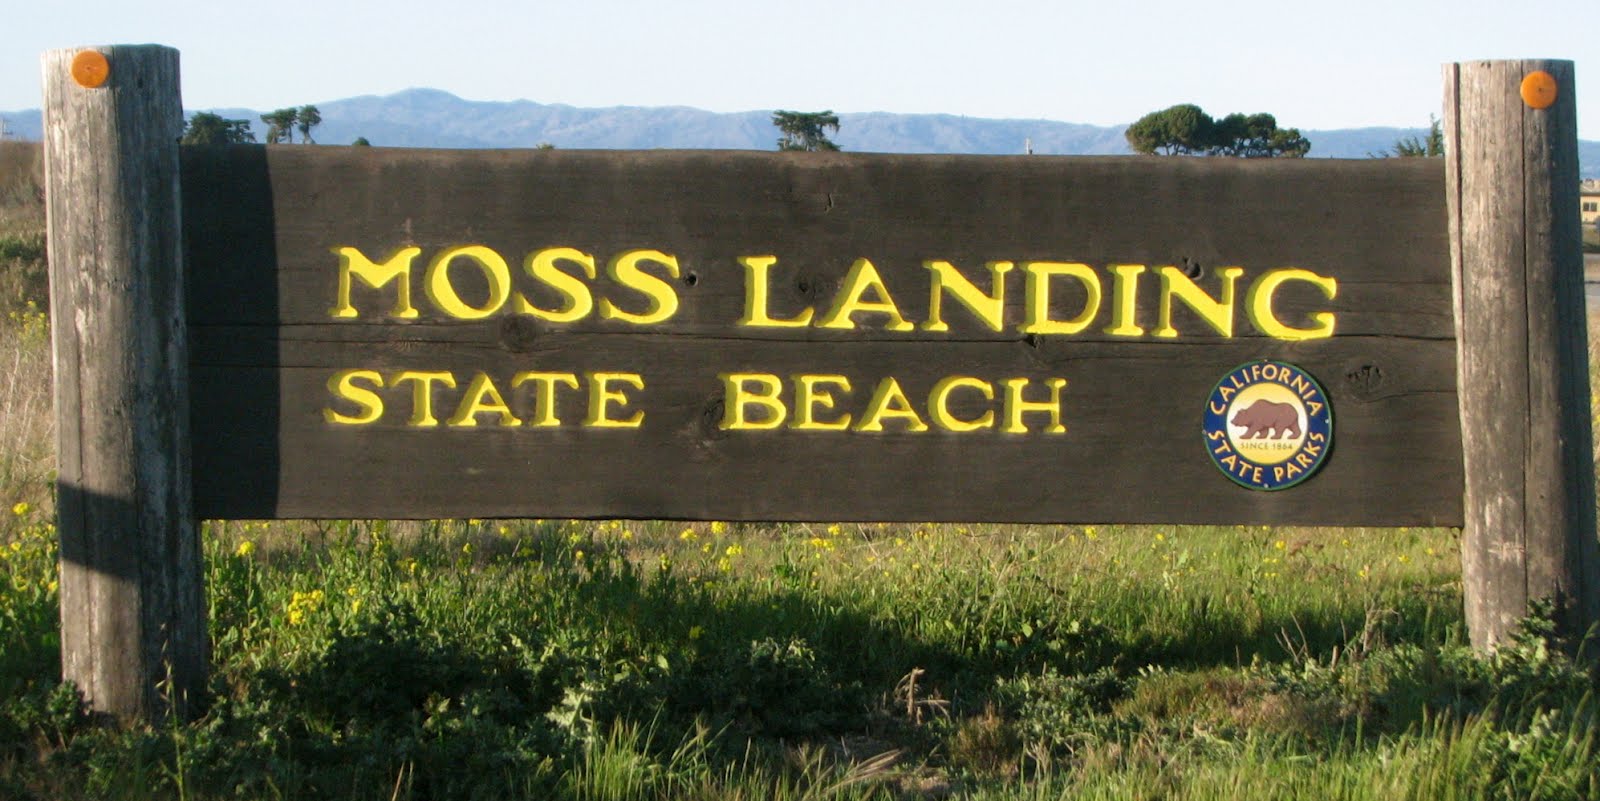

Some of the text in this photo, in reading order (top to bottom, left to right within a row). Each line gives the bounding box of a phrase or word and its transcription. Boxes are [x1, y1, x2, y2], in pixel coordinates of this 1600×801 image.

[329, 245, 1338, 341] MOSS LANDING
[324, 369, 1068, 435] STATE BEACH
[1210, 363, 1323, 416] CALIFORNIA
[1208, 430, 1324, 483] STATE PARKS
[1240, 442, 1294, 450] SINCE 1864
